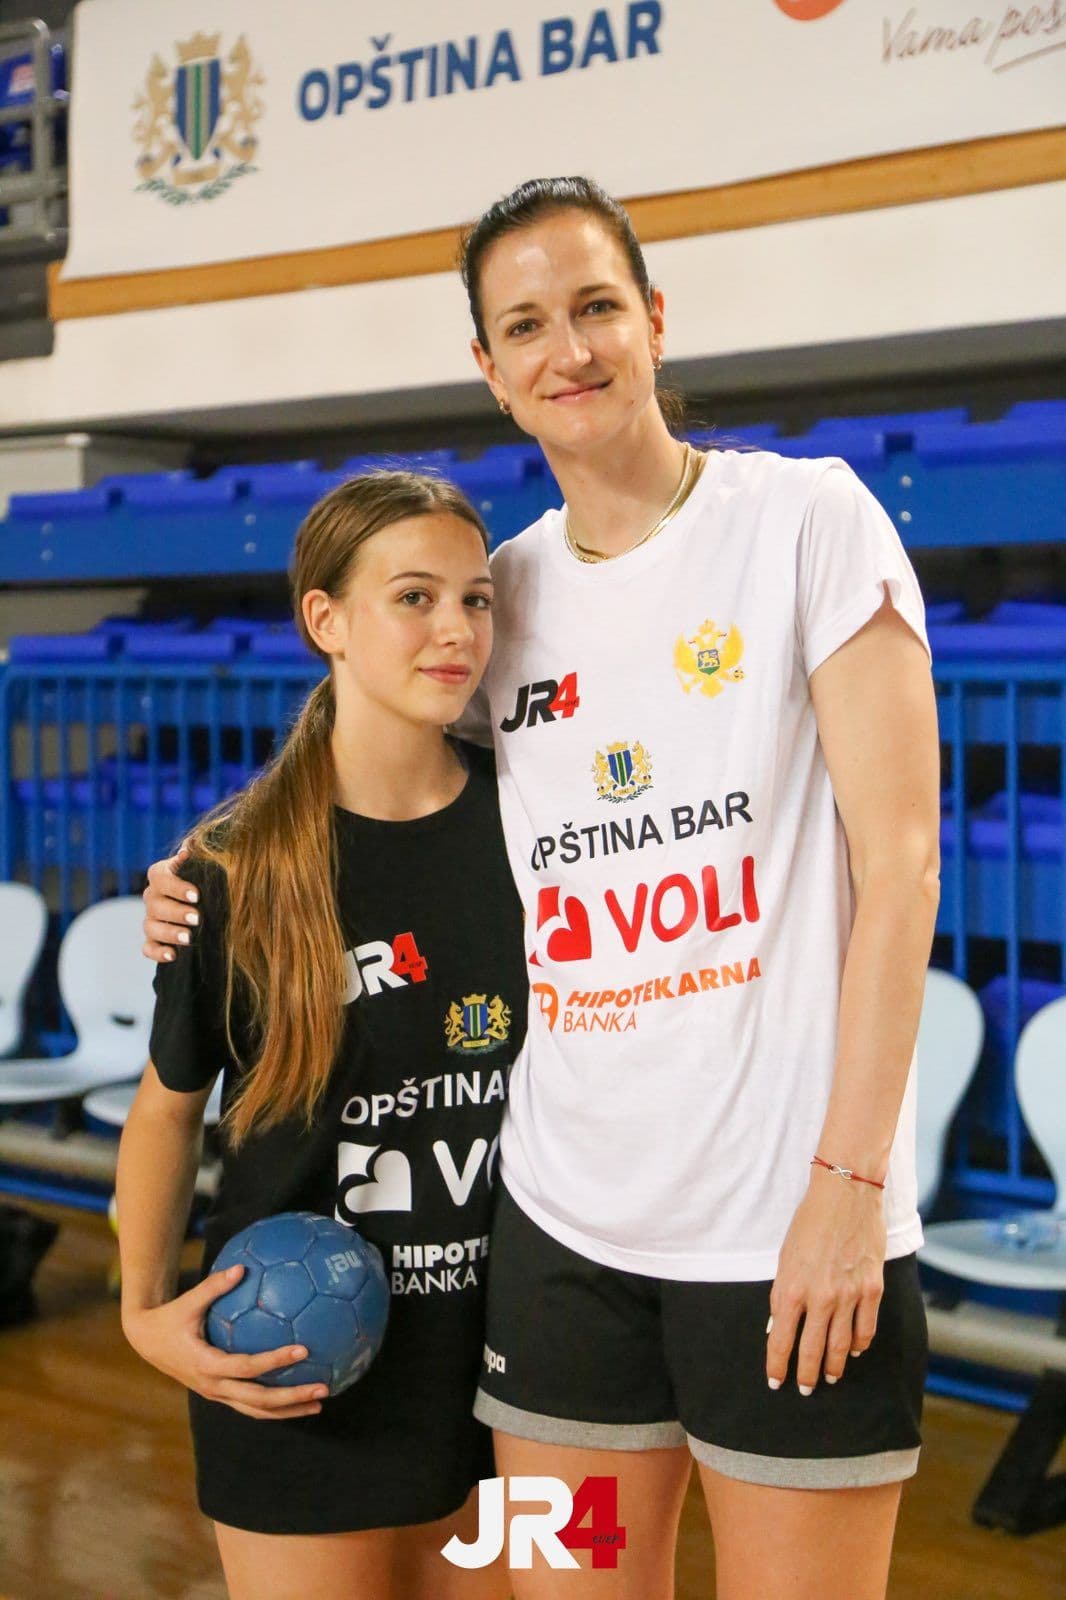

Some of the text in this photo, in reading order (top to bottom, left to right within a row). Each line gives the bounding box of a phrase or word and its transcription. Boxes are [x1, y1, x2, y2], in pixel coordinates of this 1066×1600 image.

[297, 0, 661, 122] OPŠTINA BAR
[882, 7, 980, 63] Vama
[500, 672, 580, 733] JR4
[671, 791, 753, 840] BAR
[604, 856, 760, 953] VOLI
[566, 957, 762, 1009] HIPOTEKARNA
[563, 1011, 637, 1033] BANKA
[341, 1069, 505, 1126] OPŠTINA
[391, 1266, 478, 1295] BANKA
